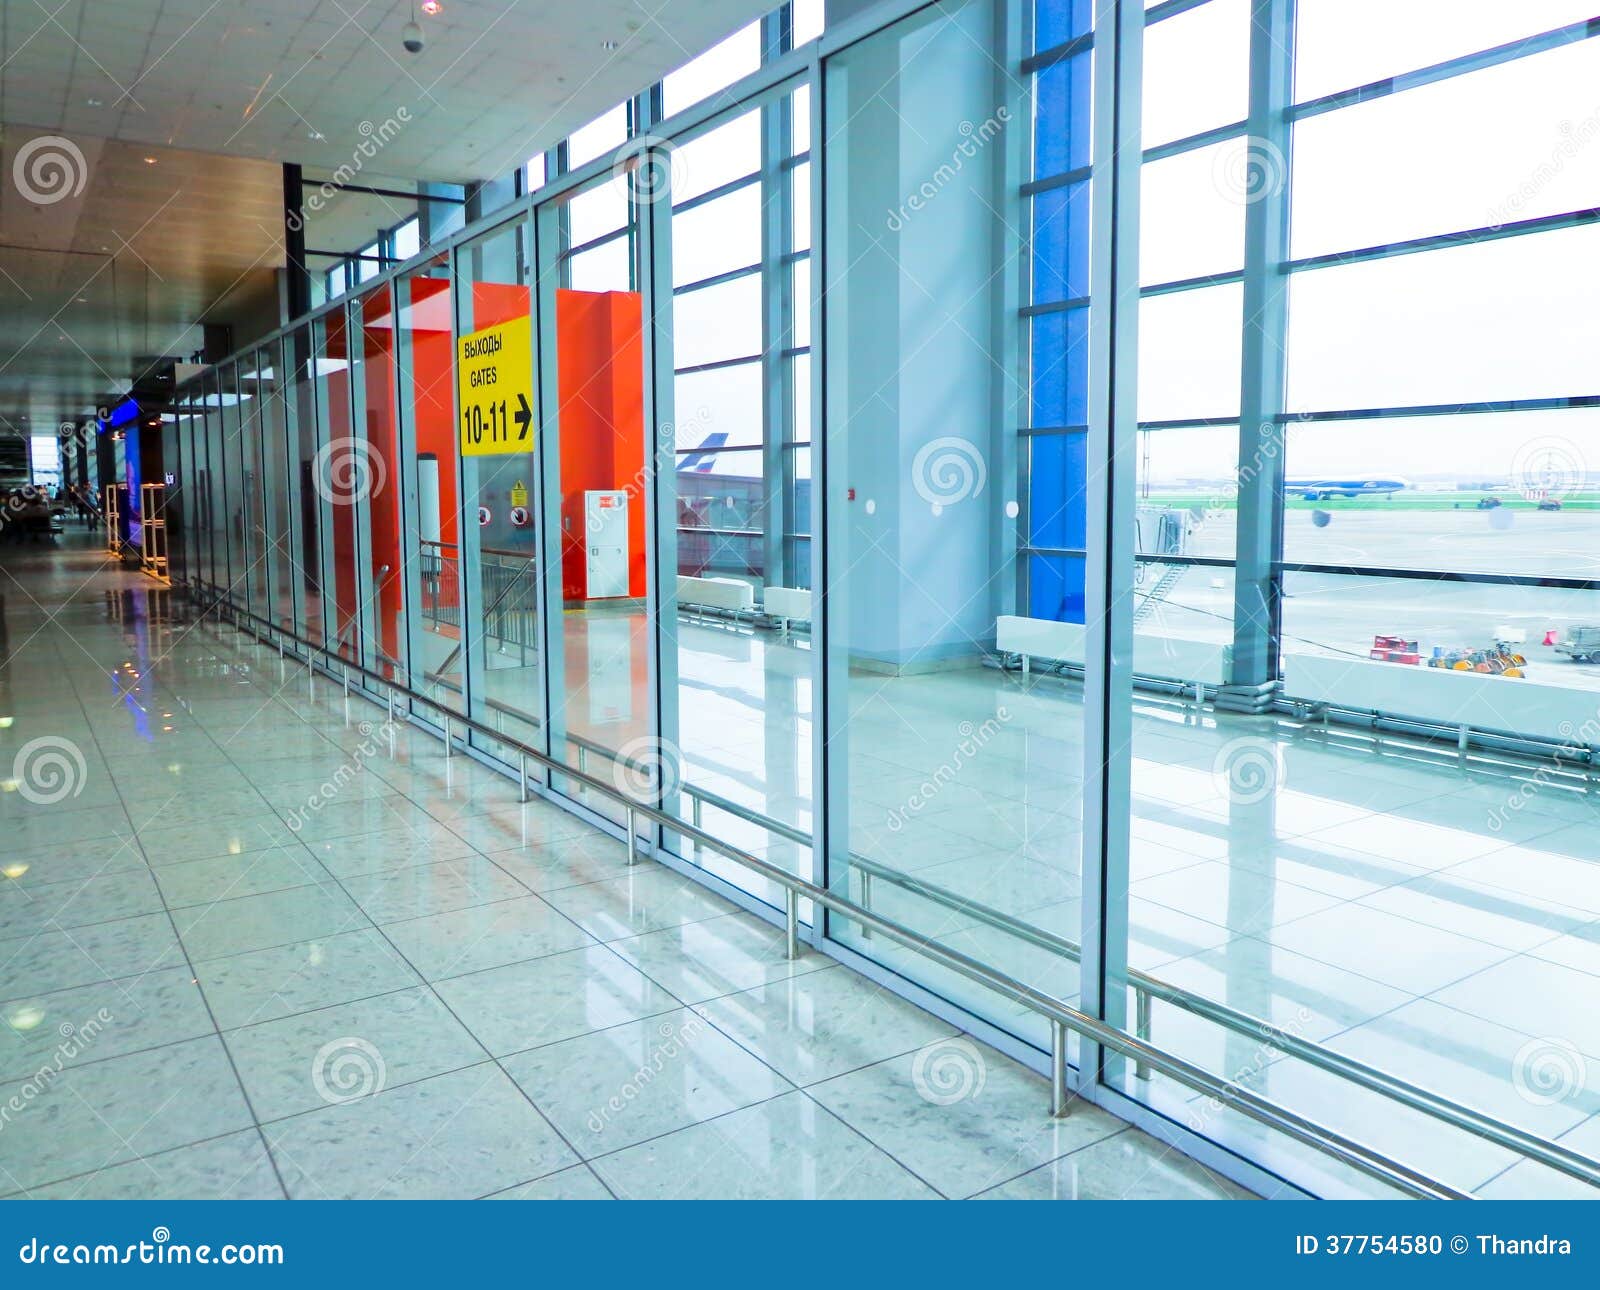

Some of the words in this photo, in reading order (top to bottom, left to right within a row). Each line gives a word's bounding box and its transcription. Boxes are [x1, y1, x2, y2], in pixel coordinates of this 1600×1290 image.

[464, 333, 502, 360] ВЫХОДЫ
[470, 366, 497, 388] GATES
[464, 399, 507, 444] 10-11
